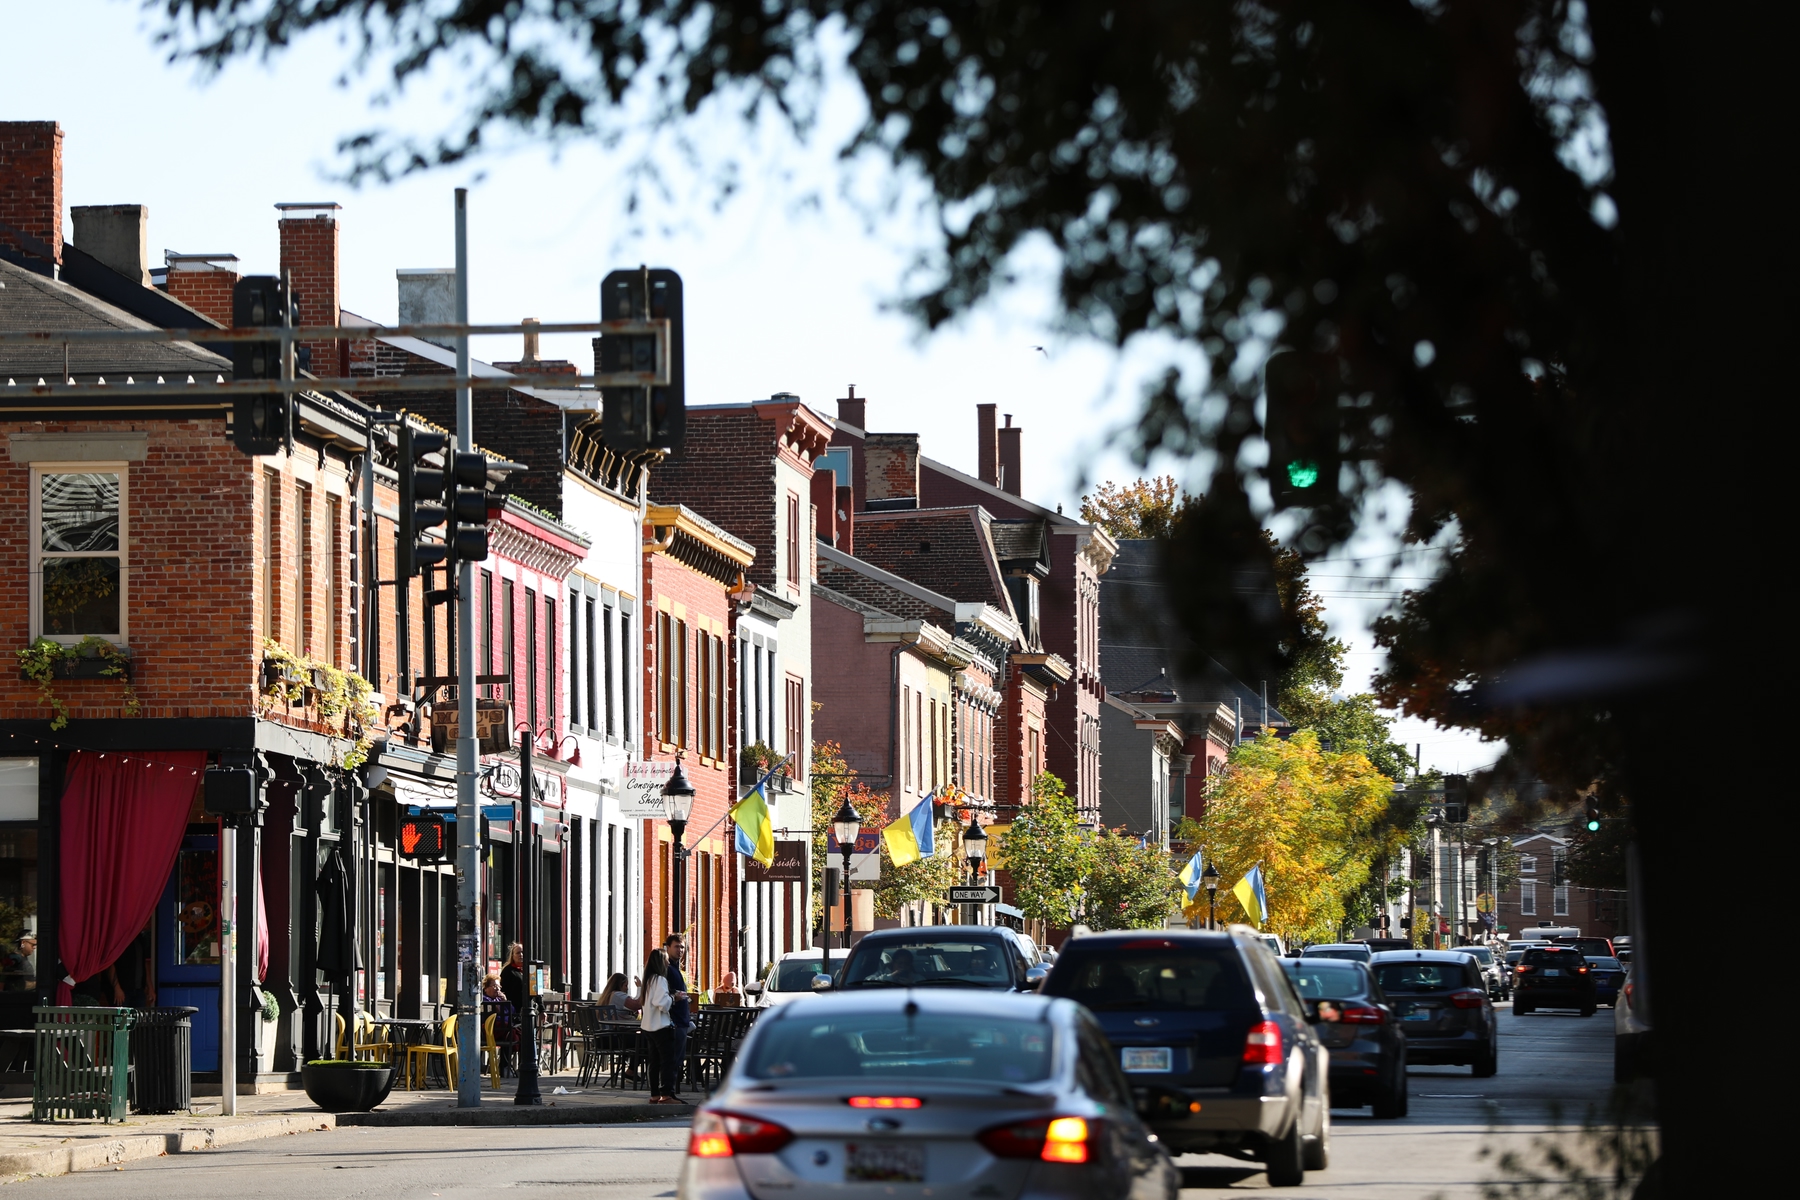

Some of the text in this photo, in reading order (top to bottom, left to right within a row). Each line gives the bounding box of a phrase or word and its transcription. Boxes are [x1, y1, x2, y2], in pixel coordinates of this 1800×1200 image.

[435, 710, 503, 724] MC'S
[449, 726, 490, 738] 64
[626, 778, 664, 793] Consignm
[638, 793, 664, 808] Shopp
[832, 836, 876, 852] Yga
[776, 857, 801, 869] sister
[954, 891, 985, 899] ONE WAY
